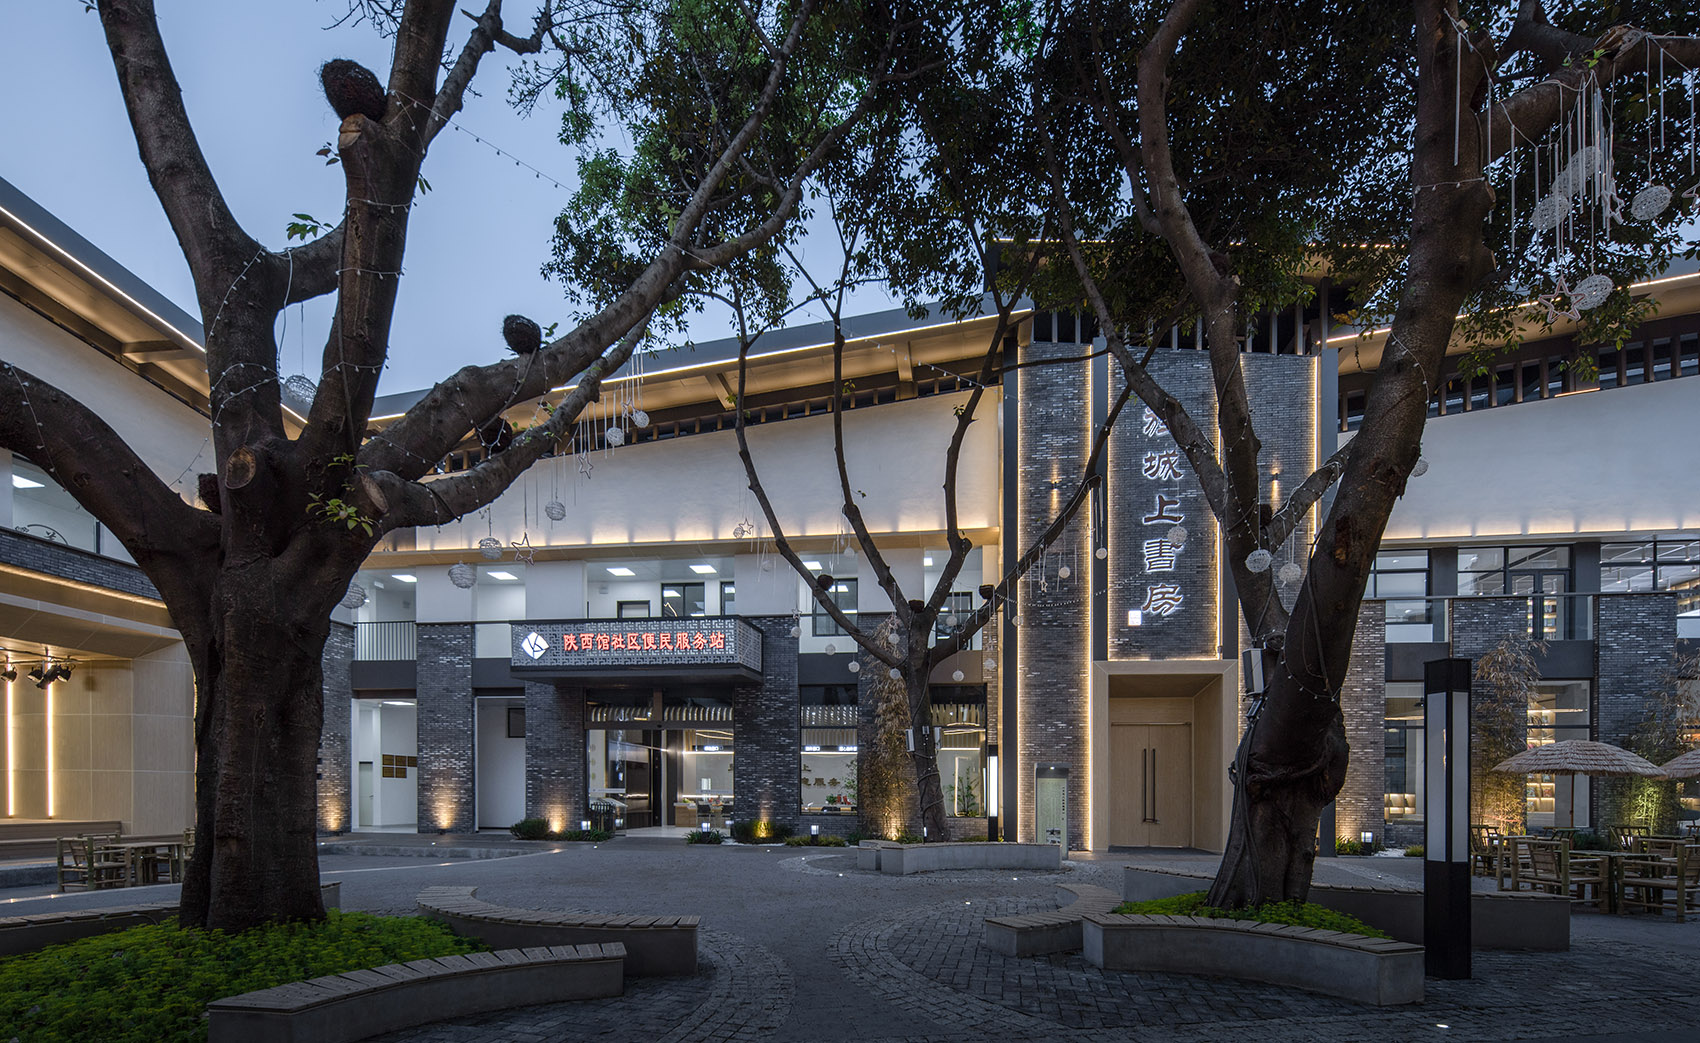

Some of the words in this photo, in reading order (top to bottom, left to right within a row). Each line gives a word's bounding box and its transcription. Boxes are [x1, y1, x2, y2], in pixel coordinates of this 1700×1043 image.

[563, 631, 725, 651] 陕西馆社区便民服务站
